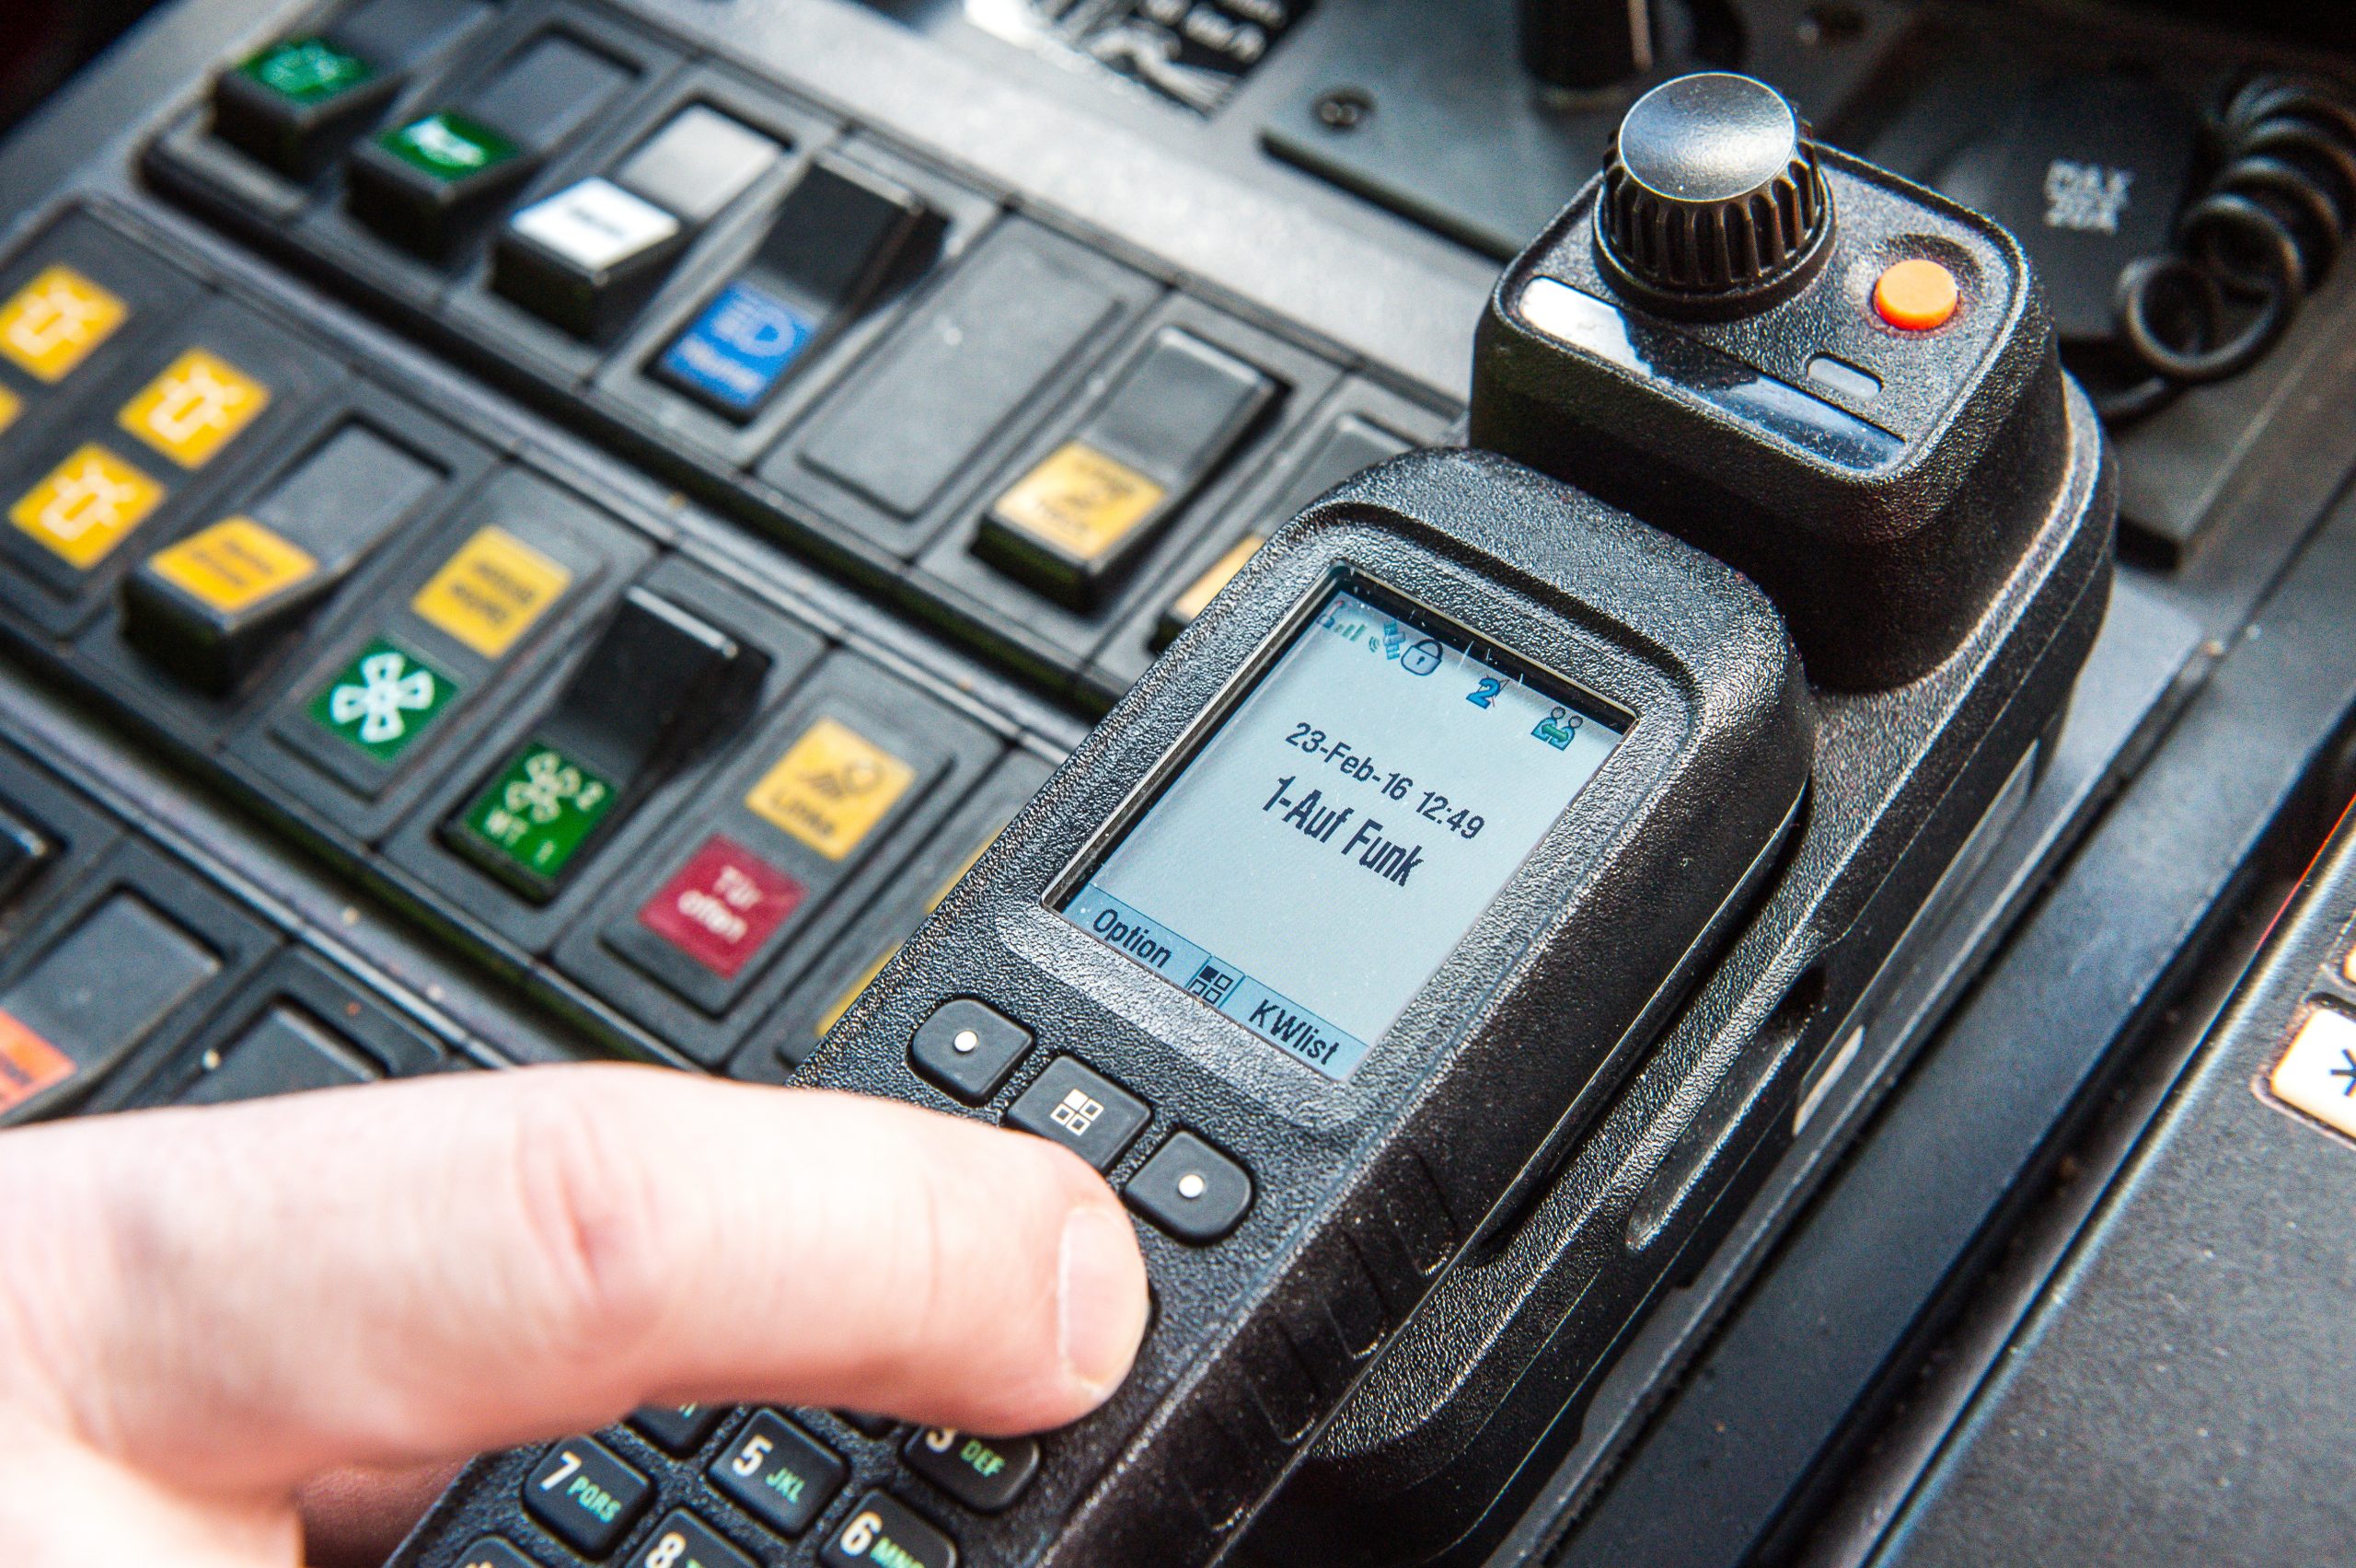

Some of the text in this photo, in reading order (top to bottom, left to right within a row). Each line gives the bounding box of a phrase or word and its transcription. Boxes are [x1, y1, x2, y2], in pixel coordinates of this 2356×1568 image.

[1284, 721, 1485, 840] 23-Feb-16 12:49
[1262, 774, 1425, 887] 1-Auf Funk
[1091, 907, 1172, 970] Option
[1248, 997, 1340, 1066] KWlist
[538, 1450, 622, 1524] 7 PQRS
[731, 1434, 806, 1505] 5 JKL
[958, 1438, 1007, 1479] DEF
[643, 1530, 687, 1568] 8
[838, 1510, 884, 1557] 6
